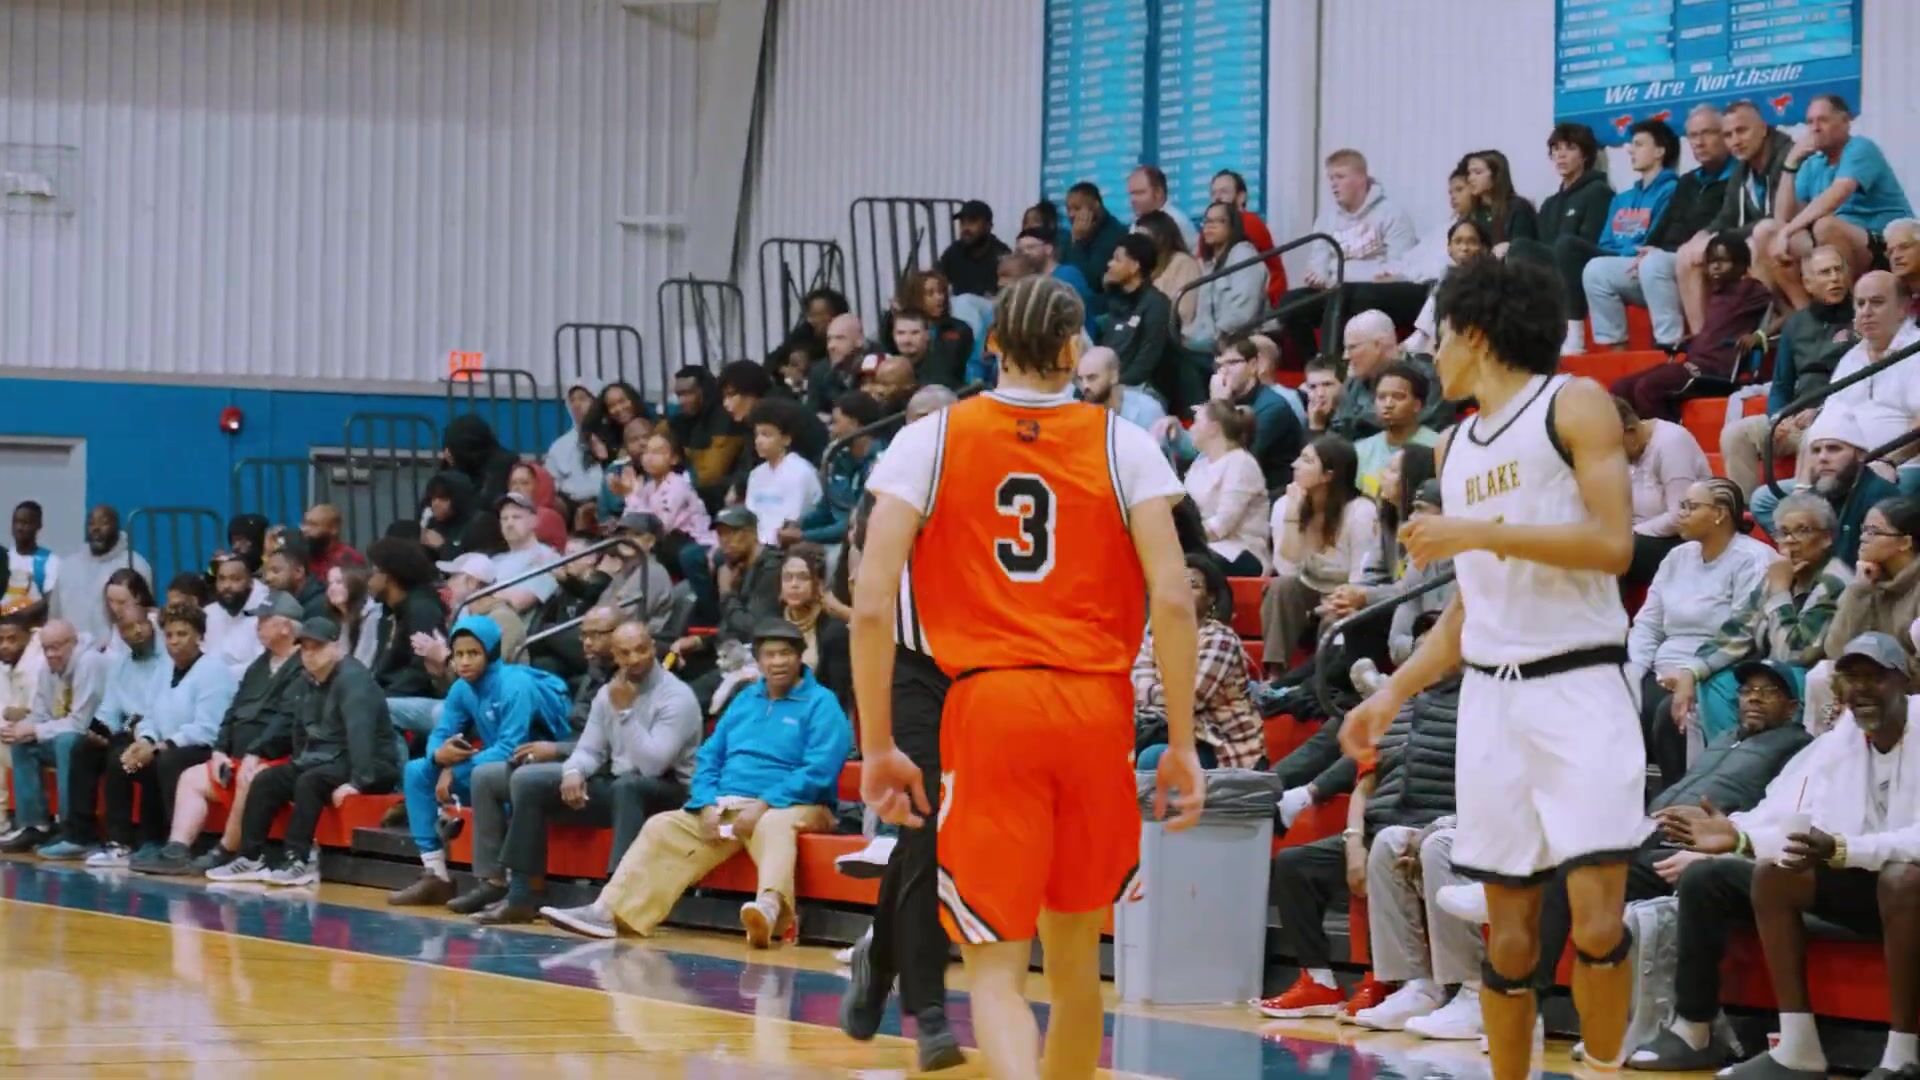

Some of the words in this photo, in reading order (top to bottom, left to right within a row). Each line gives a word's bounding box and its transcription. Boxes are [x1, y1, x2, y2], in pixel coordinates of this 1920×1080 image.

[1605, 85, 1638, 104] We
[1644, 79, 1685, 99] Are
[1695, 64, 1803, 94] Northside
[1465, 460, 1521, 506] BLAKE
[994, 472, 1057, 582] 3
